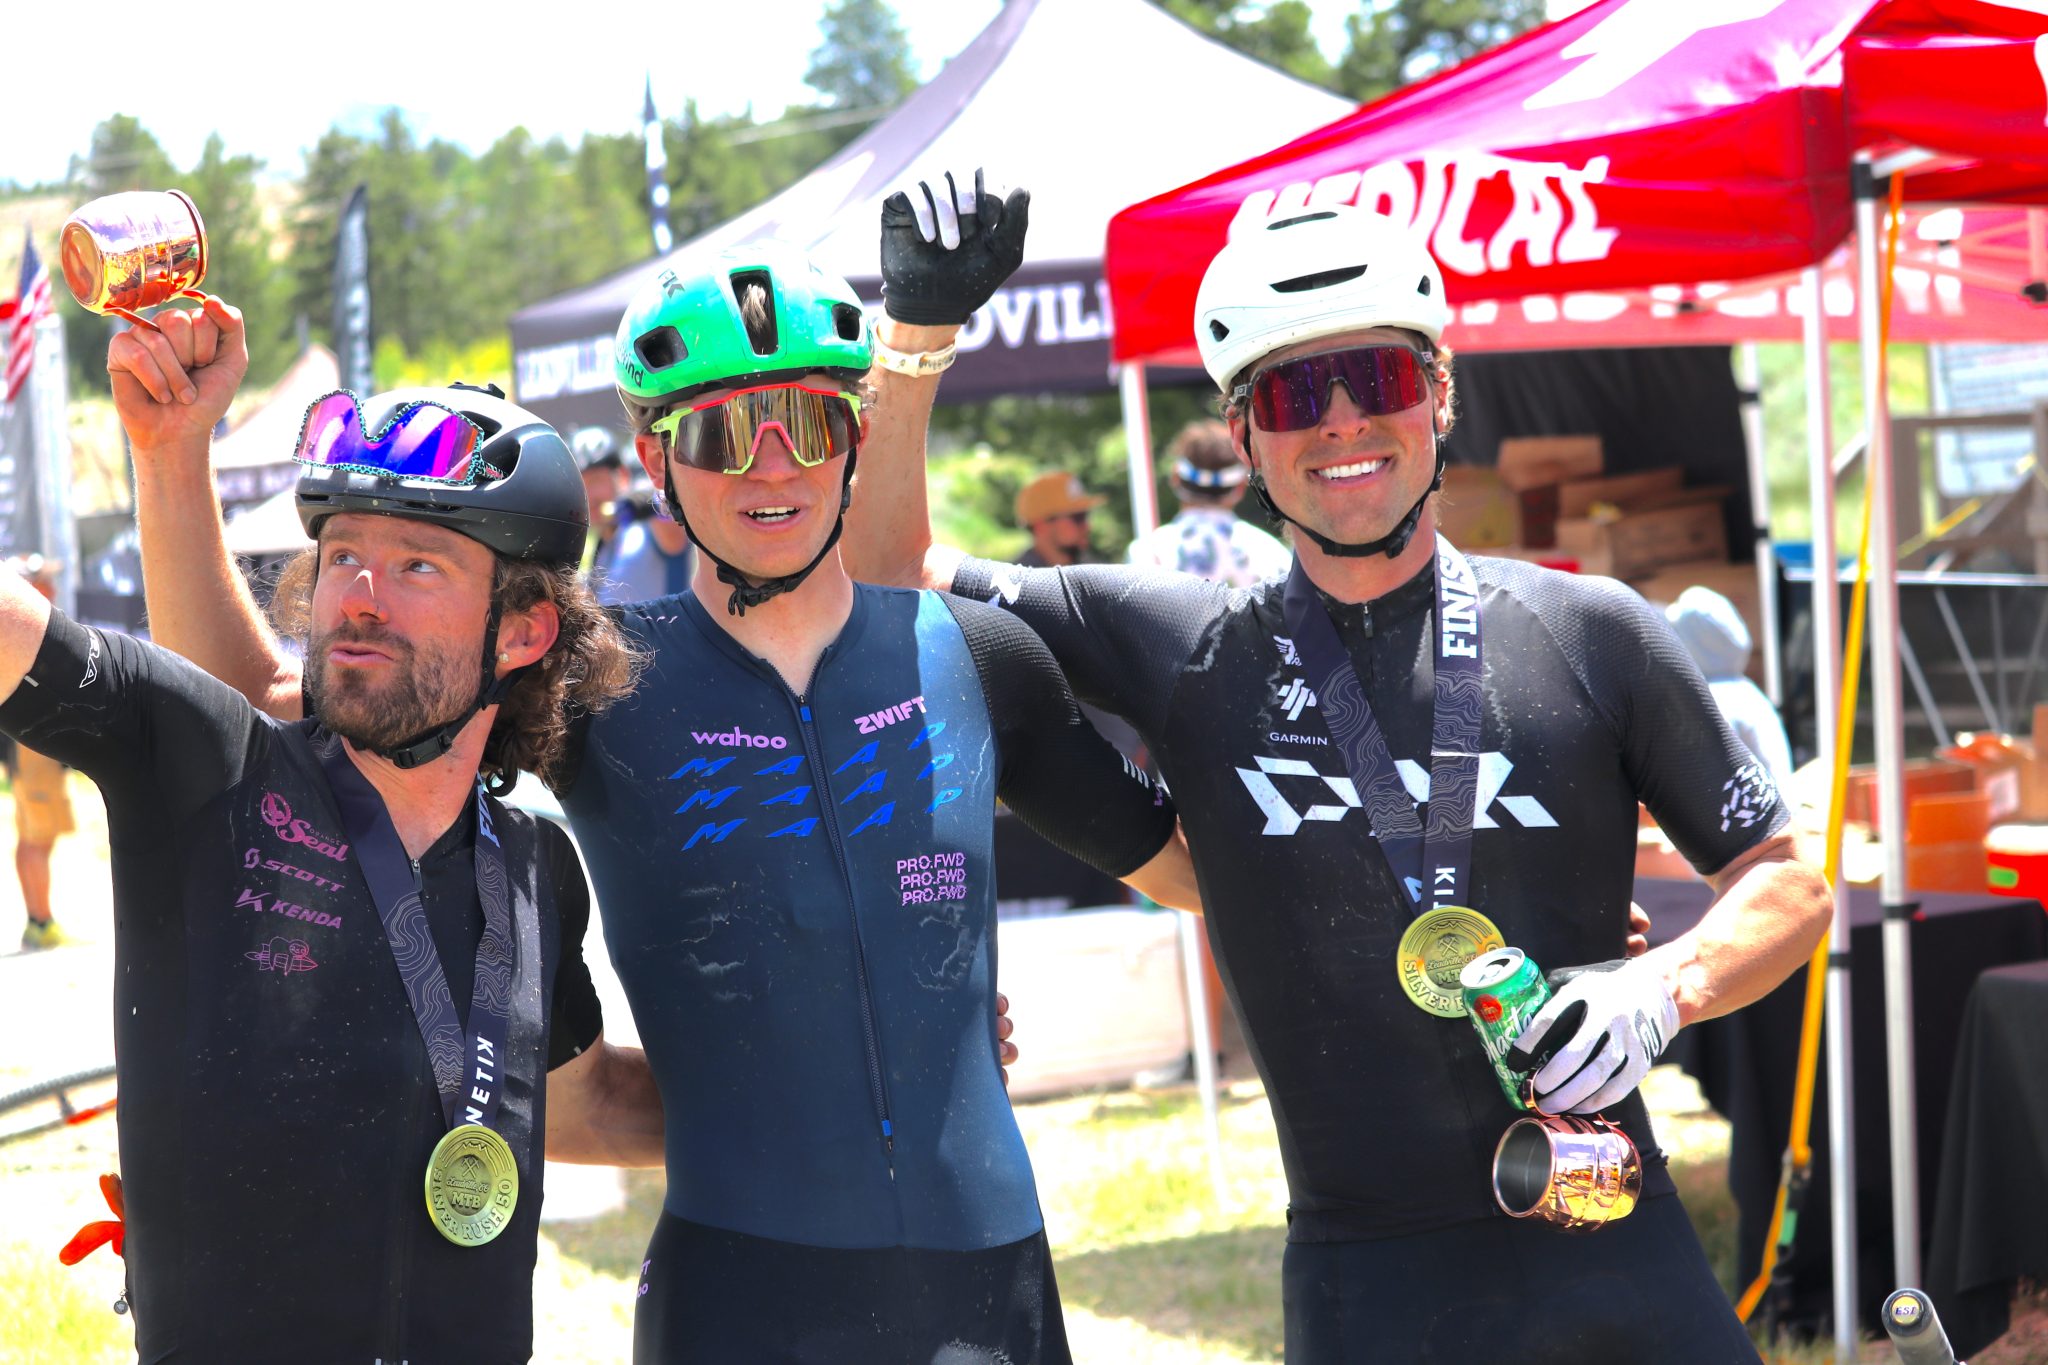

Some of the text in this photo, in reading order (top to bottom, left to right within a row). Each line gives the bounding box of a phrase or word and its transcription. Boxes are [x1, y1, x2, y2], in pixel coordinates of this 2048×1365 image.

[854, 696, 927, 734] ZWIFT
[691, 726, 787, 749] wahoo
[1269, 732, 1328, 746] GARMIN
[276, 819, 349, 862] Seal
[261, 859, 345, 892] SCOTT
[896, 852, 966, 875] PRO.FWD
[270, 899, 342, 929] KENDA
[1403, 960, 1451, 1012] SILVER
[1436, 968, 1462, 986] MT
[432, 1166, 514, 1241] SILVER RUSH 50
[451, 1190, 481, 1210] MTB
